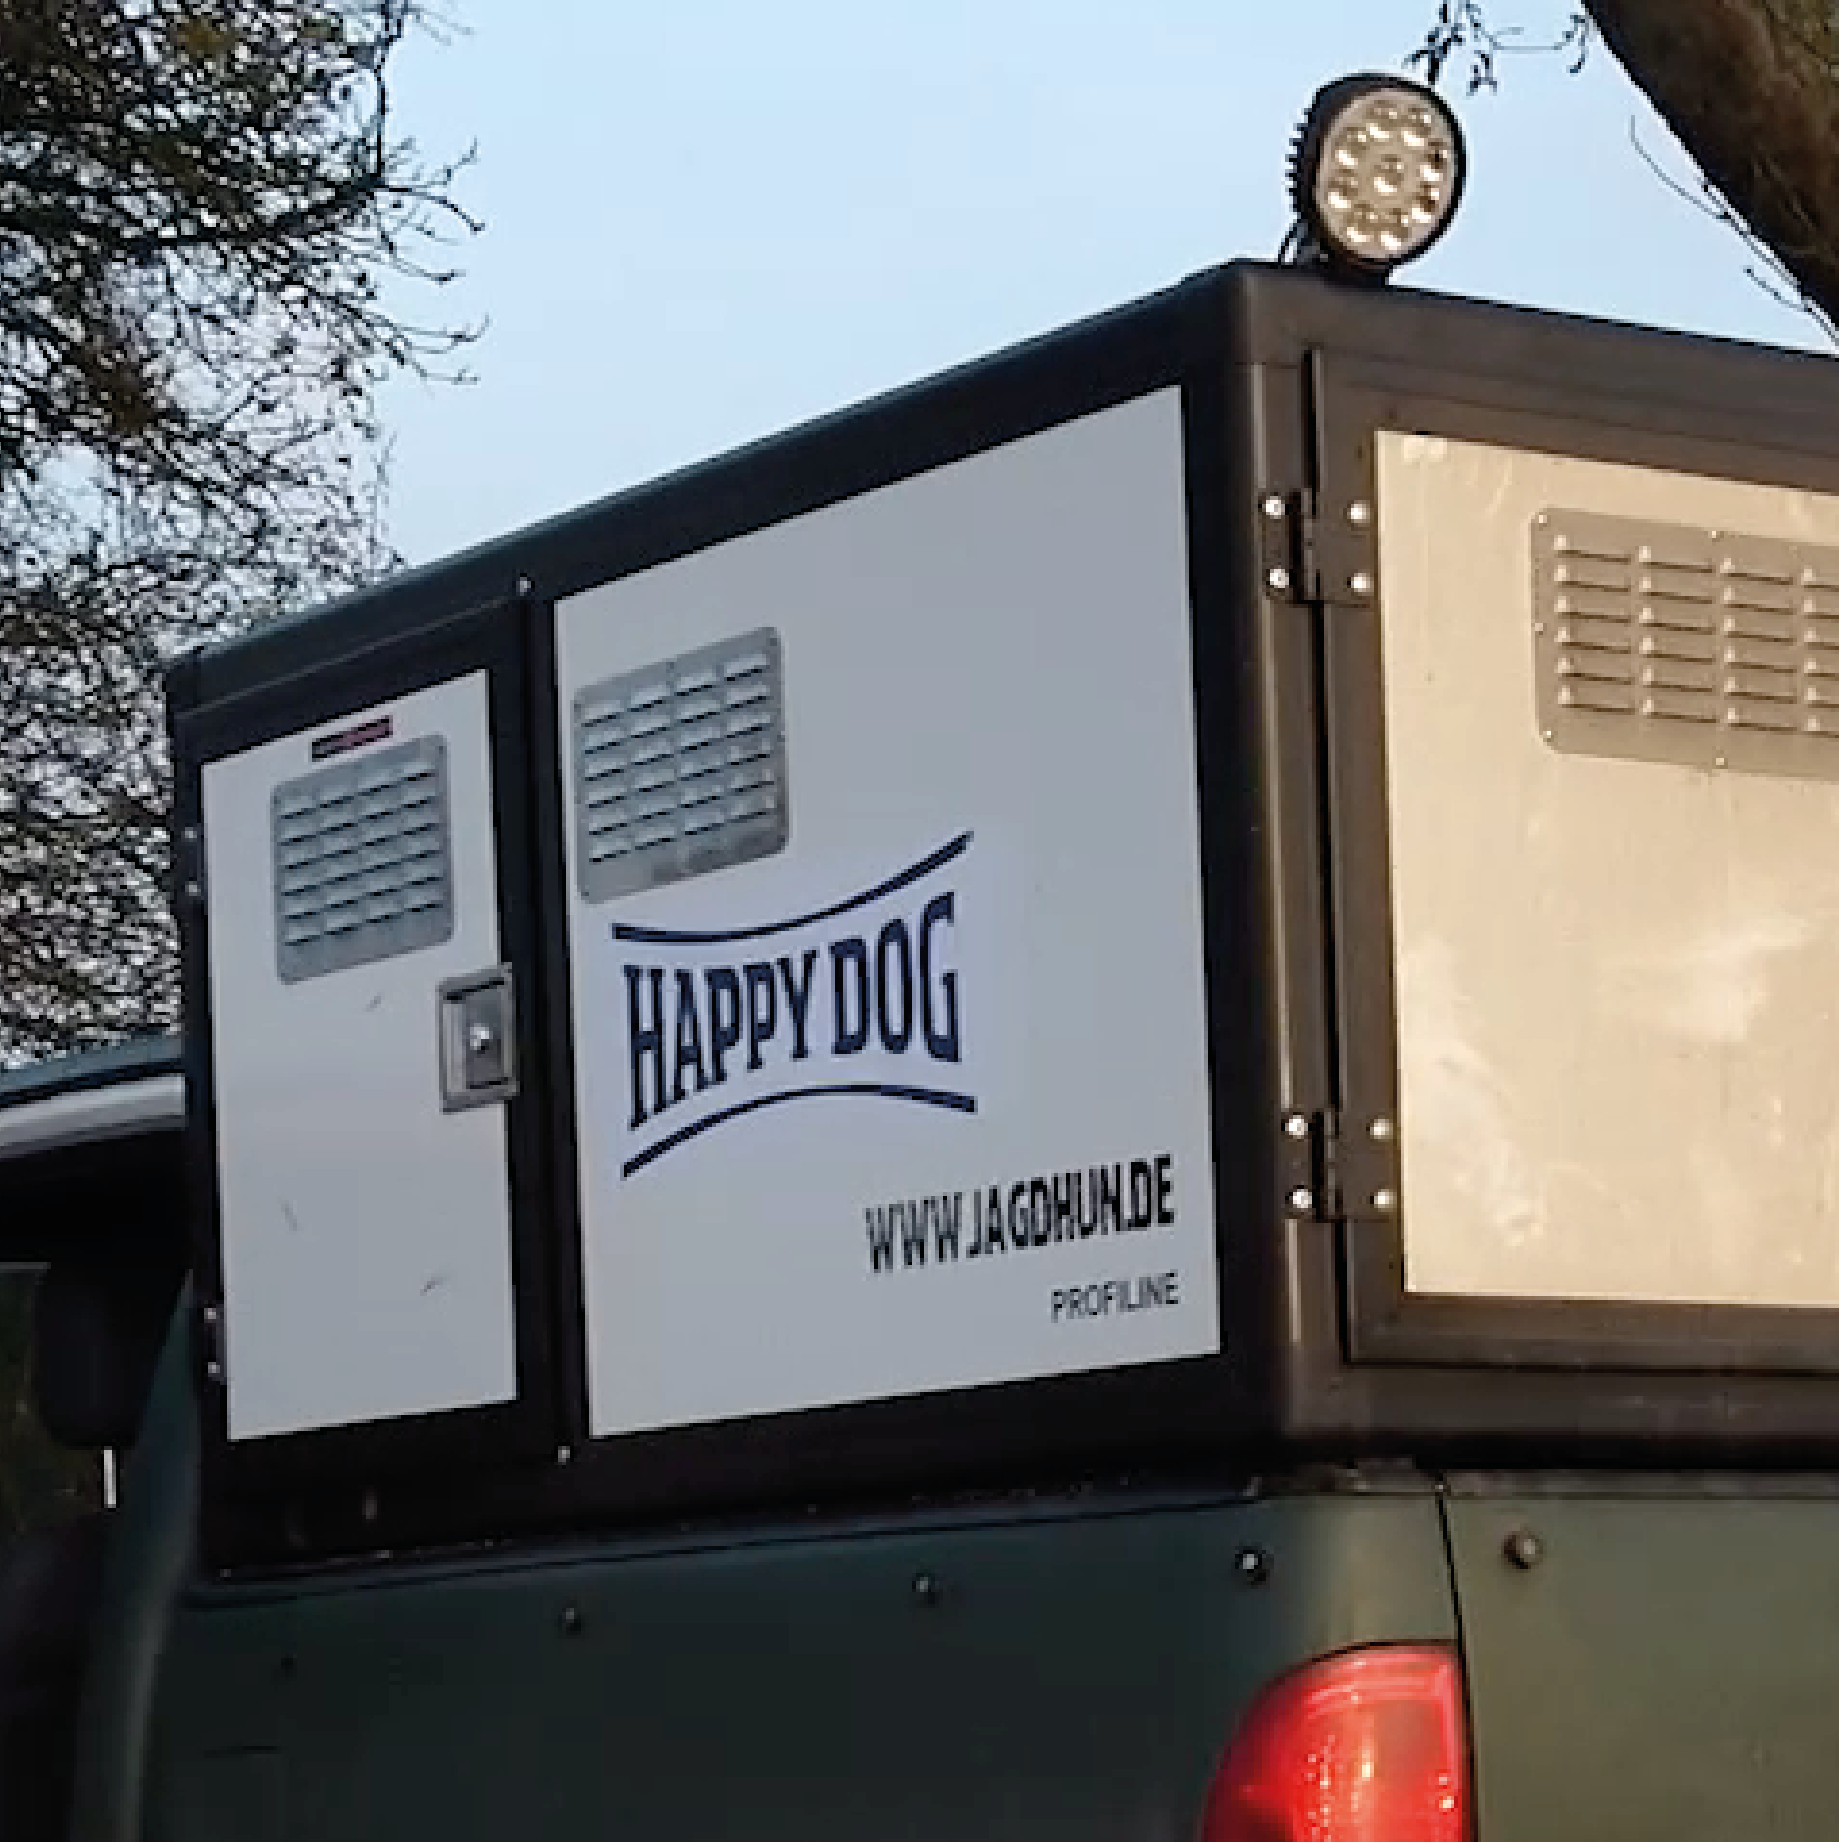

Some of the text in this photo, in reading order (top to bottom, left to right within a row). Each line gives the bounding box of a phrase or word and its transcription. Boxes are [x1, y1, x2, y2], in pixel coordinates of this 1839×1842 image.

[624, 891, 962, 1130] HAPPY DOG
[1051, 1270, 1179, 1324] PROFILINE
